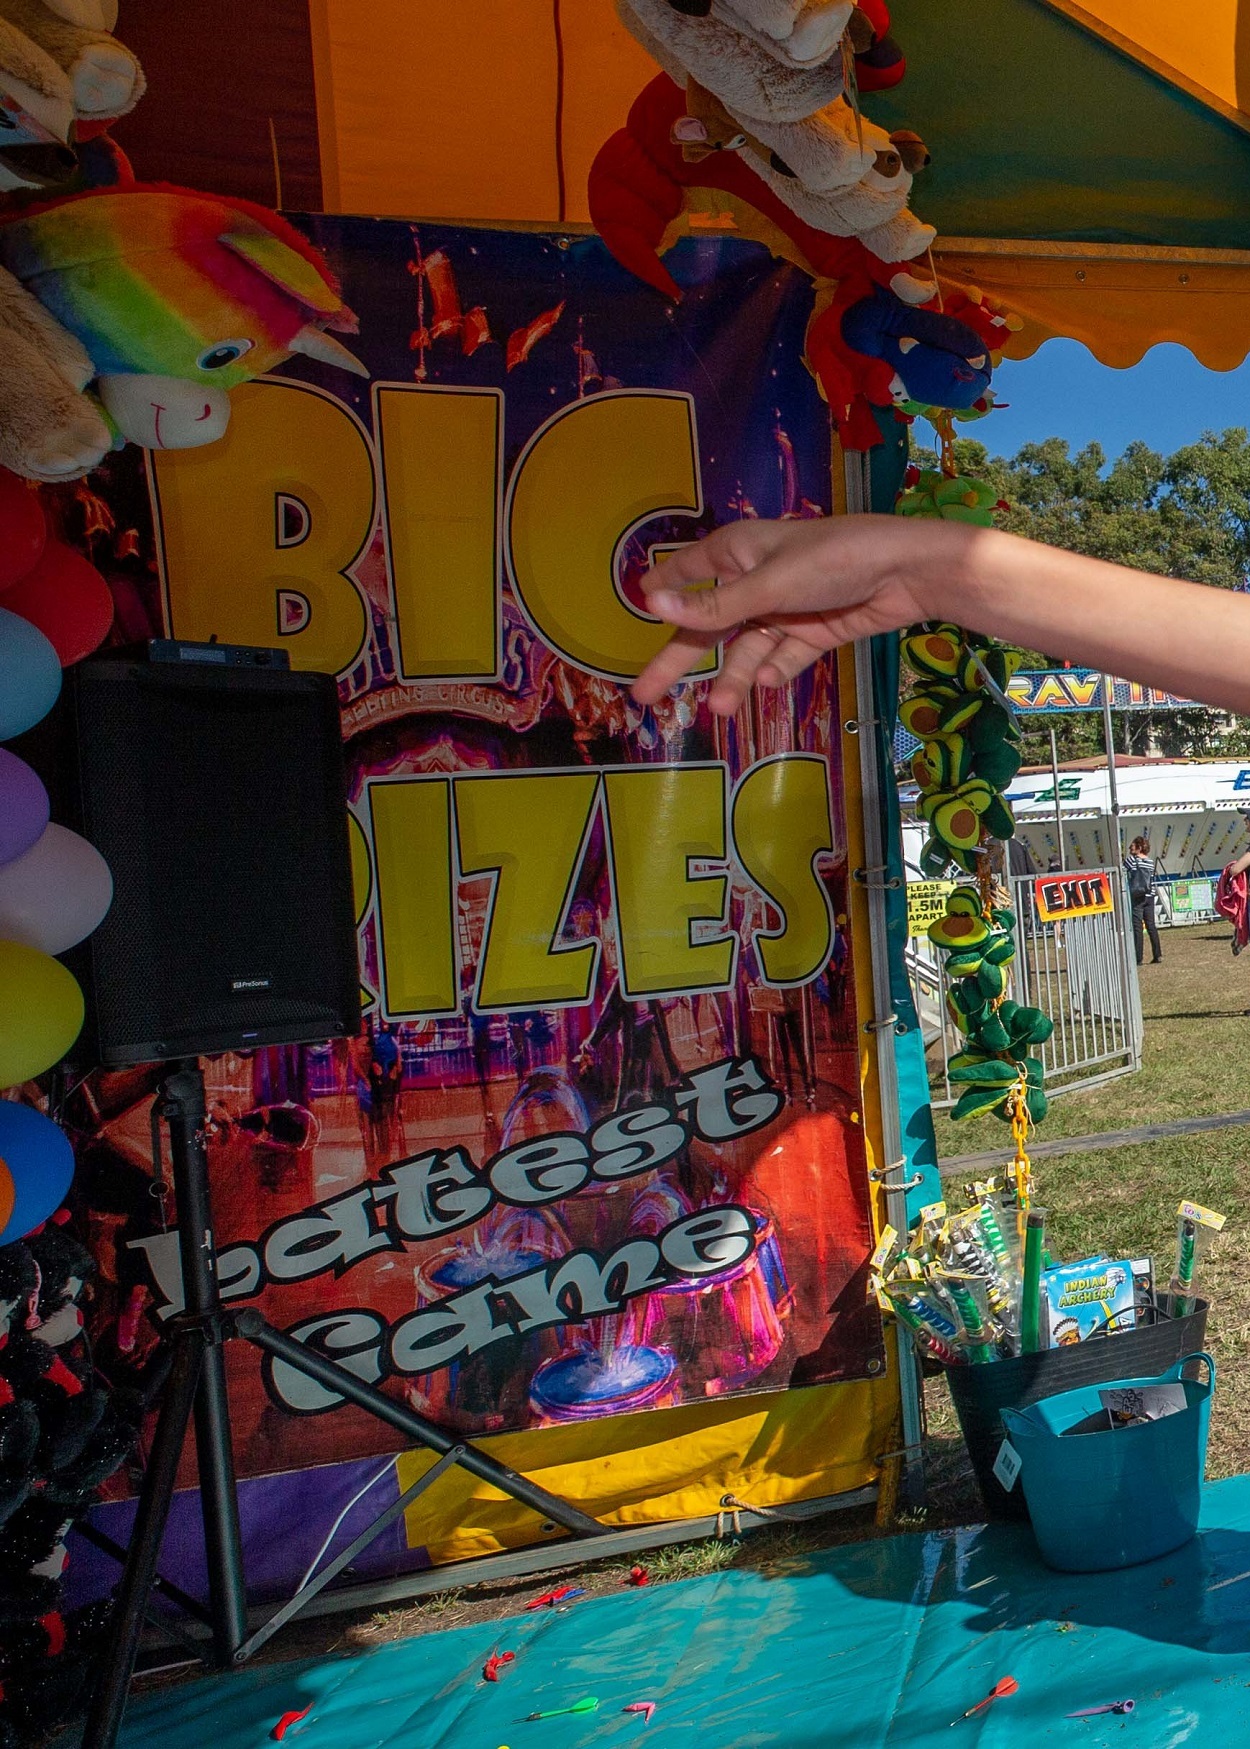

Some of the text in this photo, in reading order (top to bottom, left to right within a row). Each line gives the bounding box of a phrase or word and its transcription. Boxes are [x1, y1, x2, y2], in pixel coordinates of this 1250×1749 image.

[144, 376, 721, 685] BIG
[360, 752, 836, 1023] IZES
[910, 891, 937, 900] KEEP
[1041, 878, 1106, 913] EXIT
[907, 899, 943, 914] 1.5M
[909, 912, 944, 922] APART
[126, 1056, 785, 1322] Latest
[1058, 1286, 1117, 1308] ARCHERY
[1064, 1275, 1109, 1293] INDIAN
[264, 1204, 757, 1416] Game
